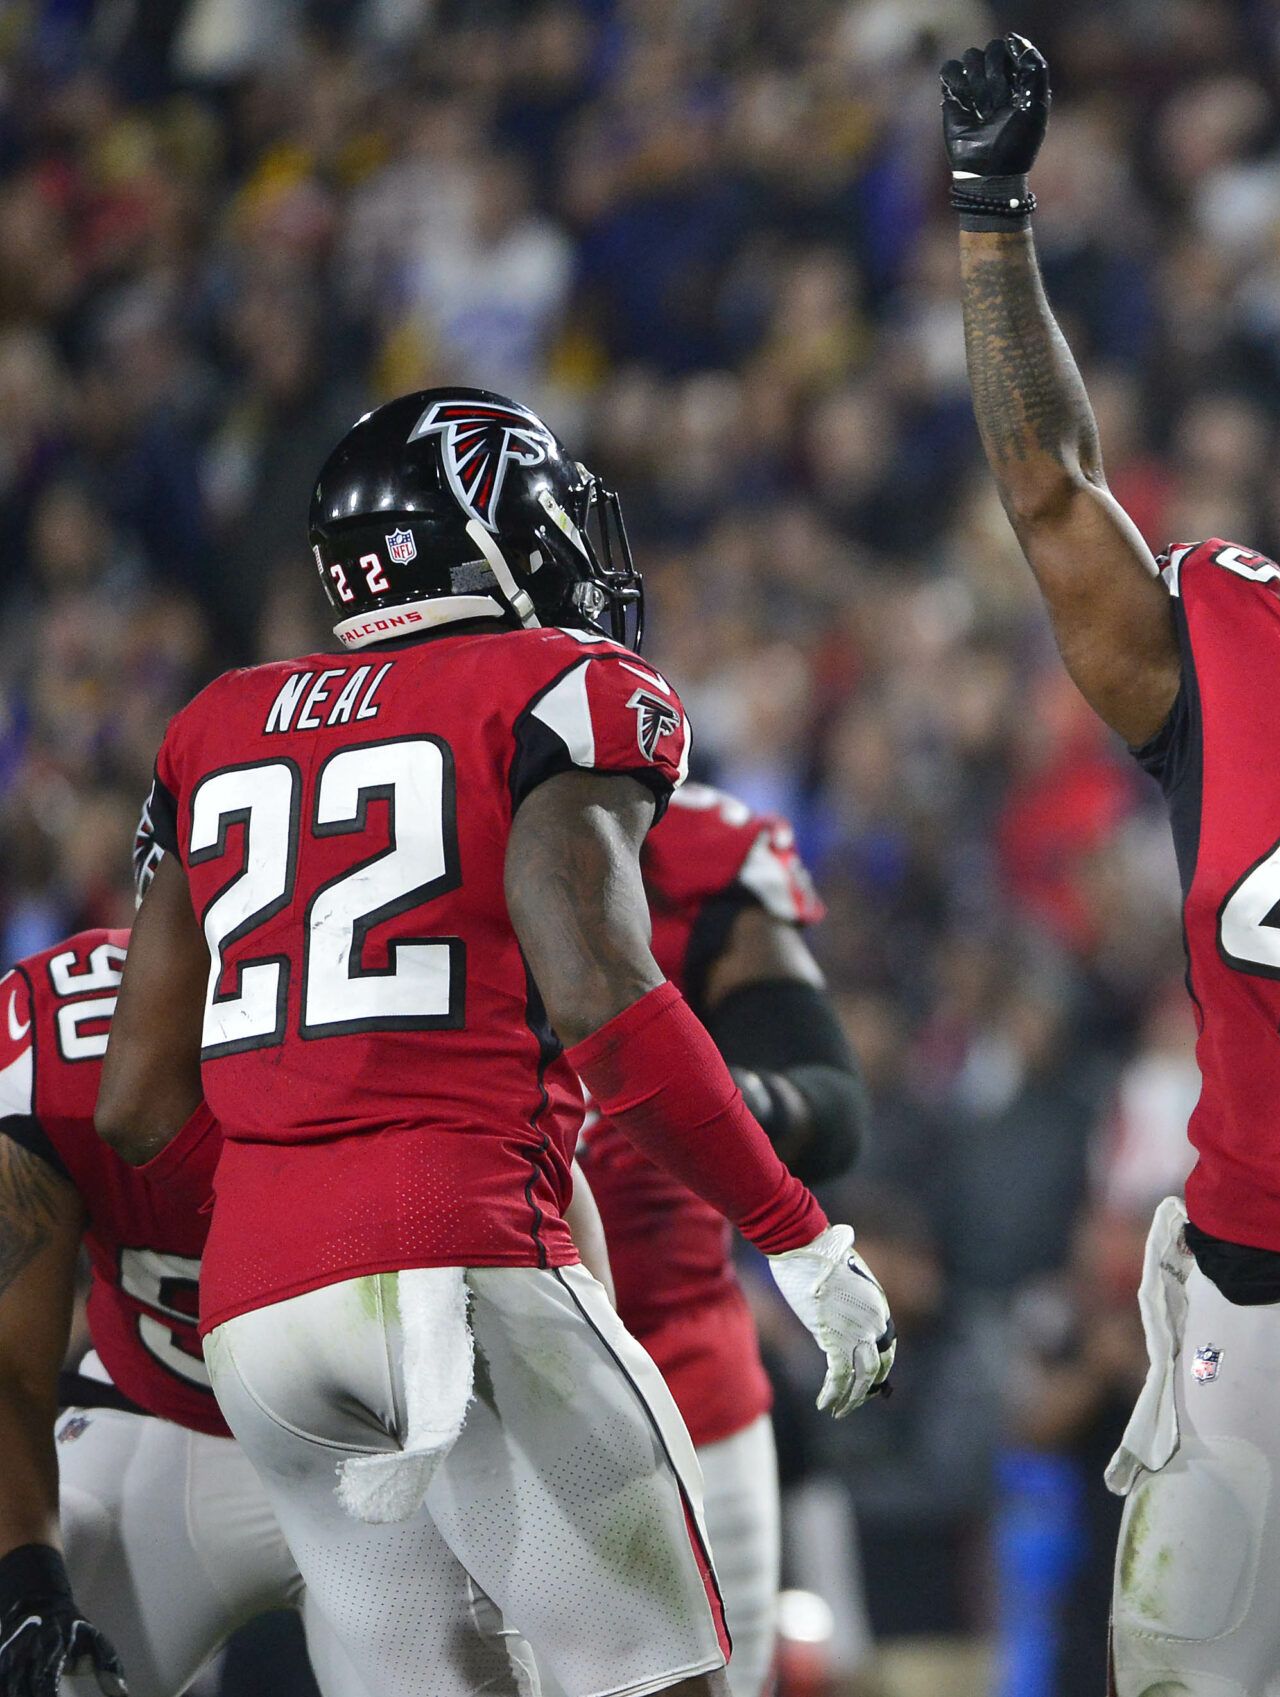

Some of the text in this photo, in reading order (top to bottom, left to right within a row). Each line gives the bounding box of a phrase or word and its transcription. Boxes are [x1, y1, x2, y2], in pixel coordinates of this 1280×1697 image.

[393, 544, 413, 559] NFL
[340, 611, 423, 644] FALCONS
[263, 661, 396, 735] NEAL
[188, 733, 463, 1059] 22
